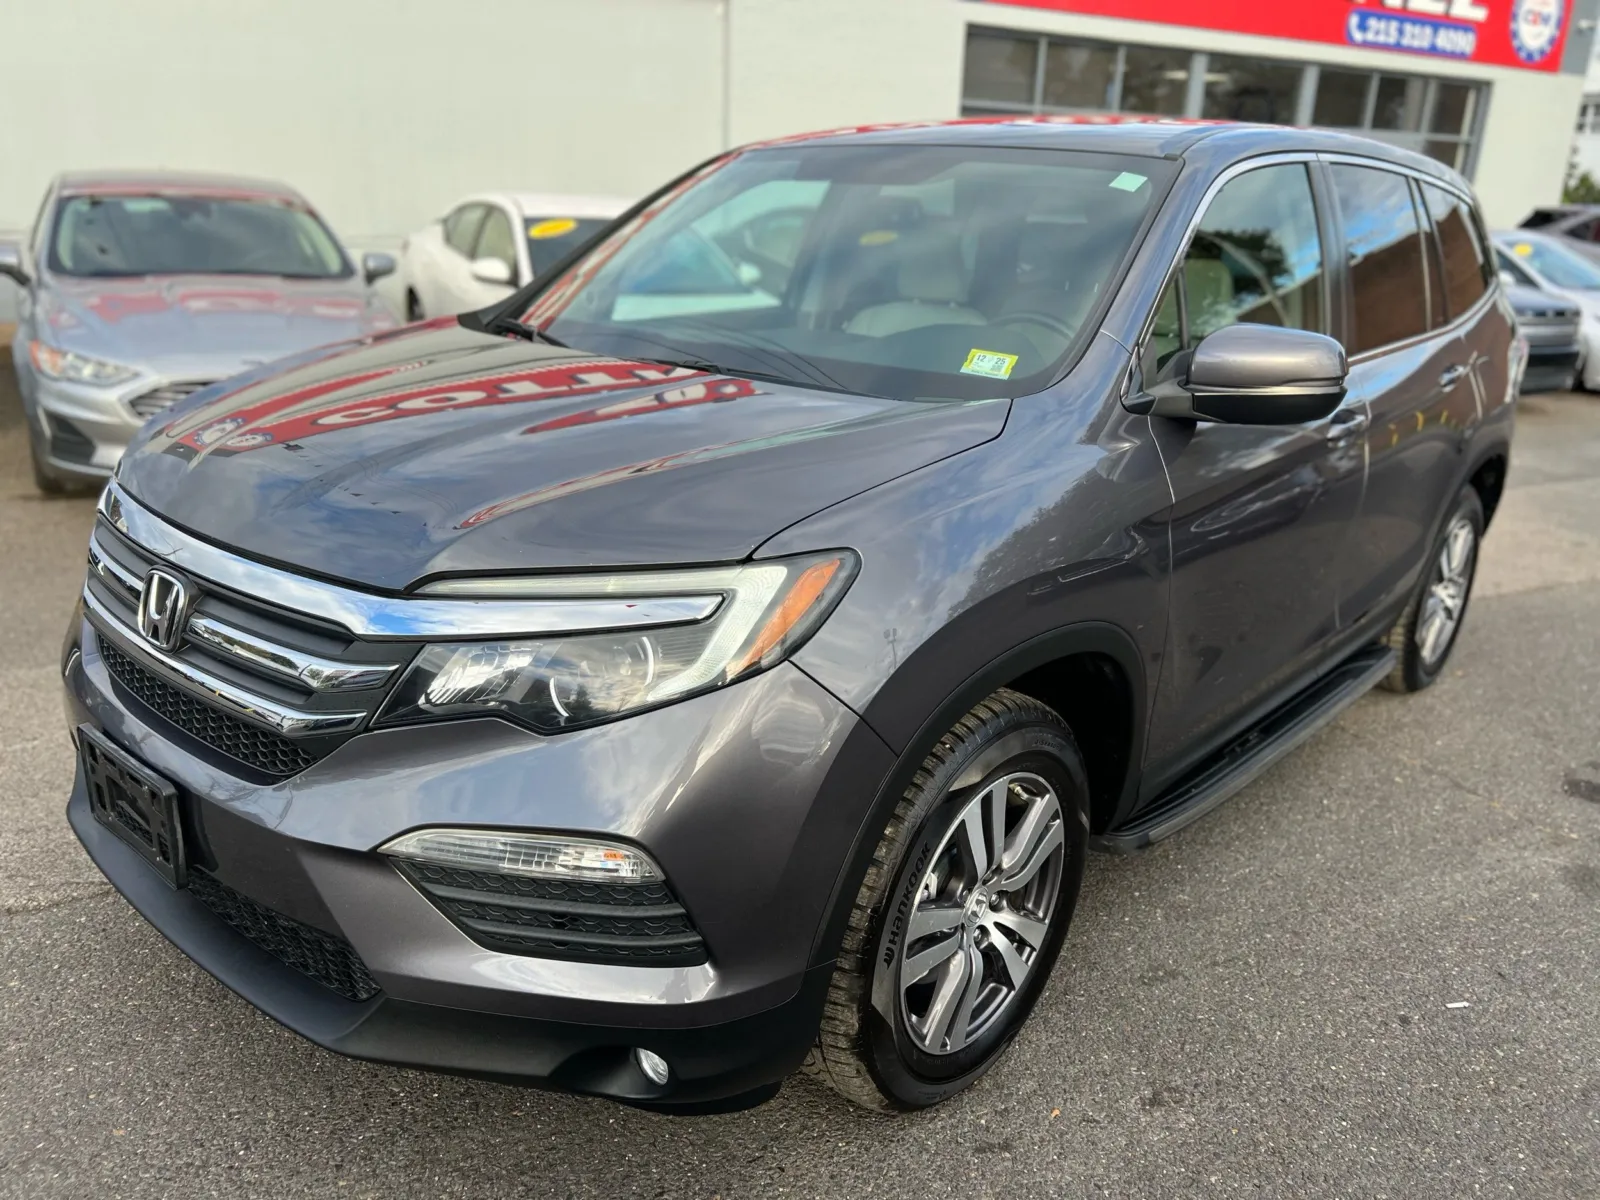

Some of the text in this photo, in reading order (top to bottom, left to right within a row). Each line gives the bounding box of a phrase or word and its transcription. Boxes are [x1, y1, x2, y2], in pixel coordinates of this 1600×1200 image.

[1365, 16, 1399, 43] 215
[976, 354, 1006, 365] 12 25
